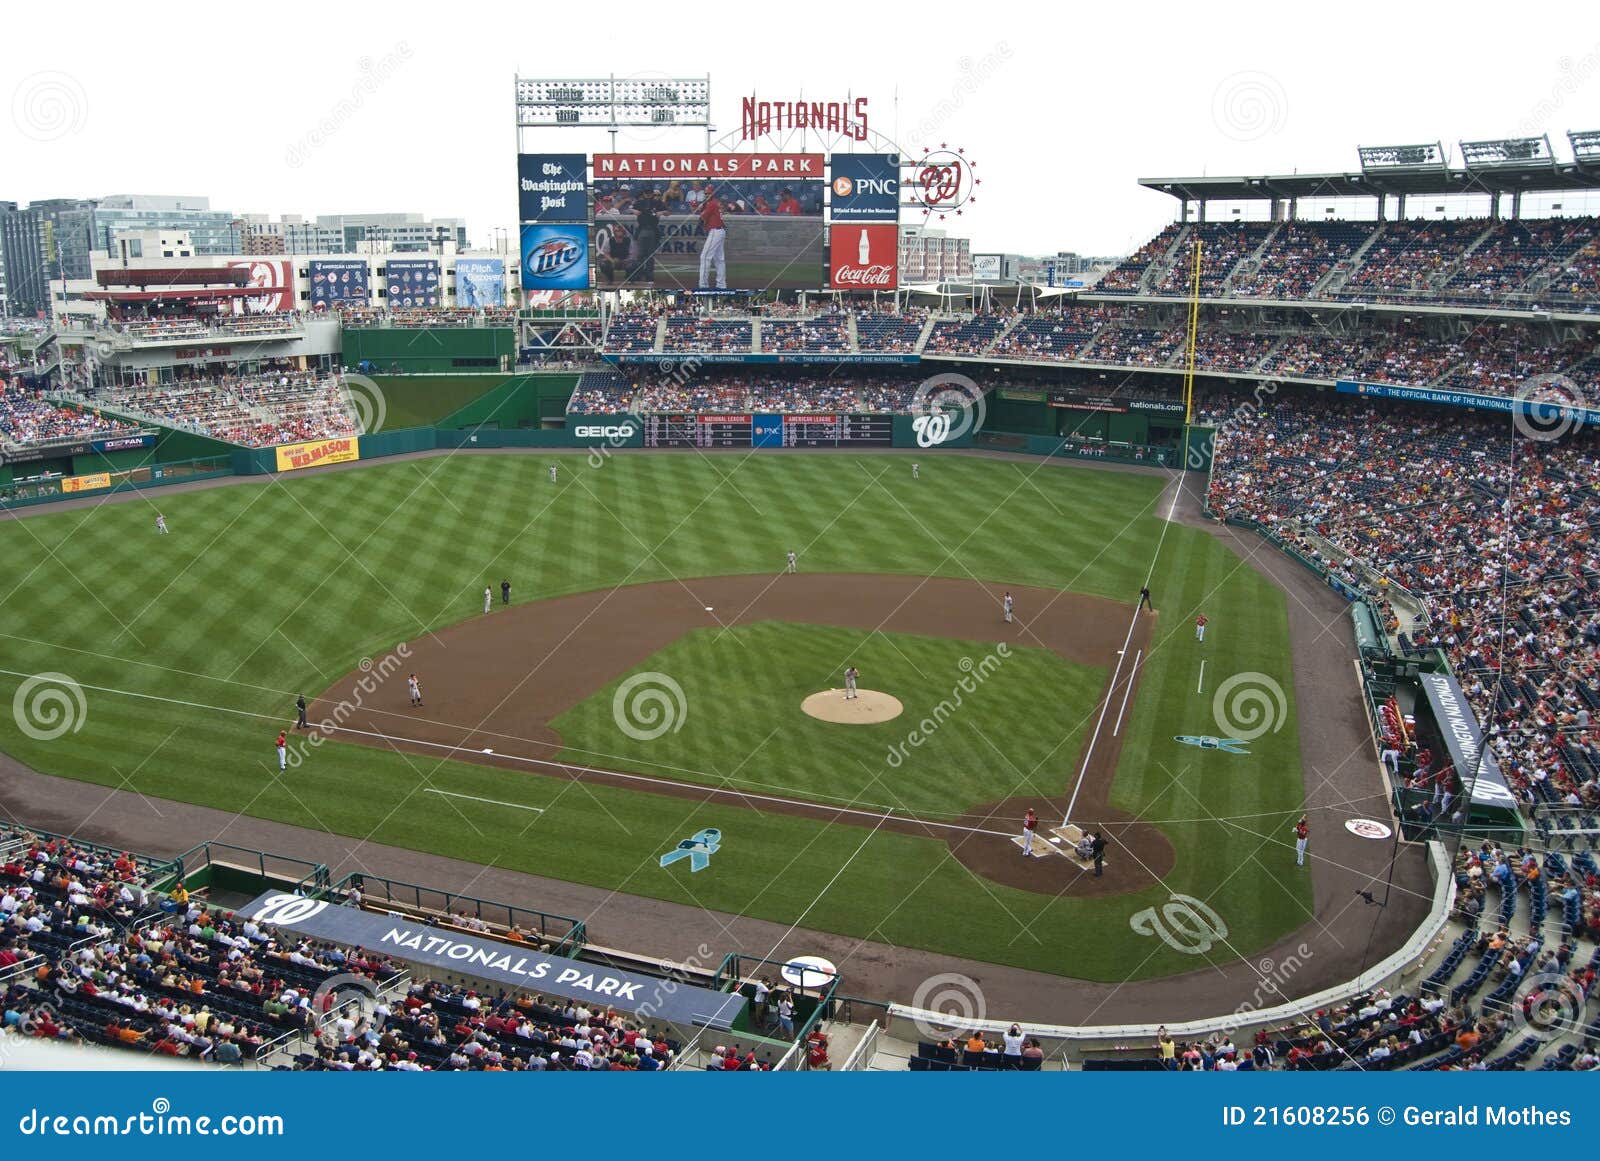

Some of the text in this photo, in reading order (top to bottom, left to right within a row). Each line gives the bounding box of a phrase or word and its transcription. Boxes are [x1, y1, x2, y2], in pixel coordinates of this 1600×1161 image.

[742, 96, 868, 141] NATIONALS
[542, 163, 562, 176] The
[602, 159, 812, 172] NATIONALS PARK
[520, 178, 585, 194] Washington
[855, 179, 897, 195] PNC
[541, 196, 566, 212] Post
[835, 264, 895, 285] Coca-Cola
[1130, 400, 1184, 411] nationals.com
[1366, 386, 1513, 410] PNC THE OFFICIAL BANK OF THE NATIONALS
[574, 425, 633, 438] GEICO
[912, 414, 950, 448] W
[1431, 677, 1463, 717] NATIONALS
[252, 894, 330, 925] W
[380, 927, 645, 1001] NATIONALS PARK
